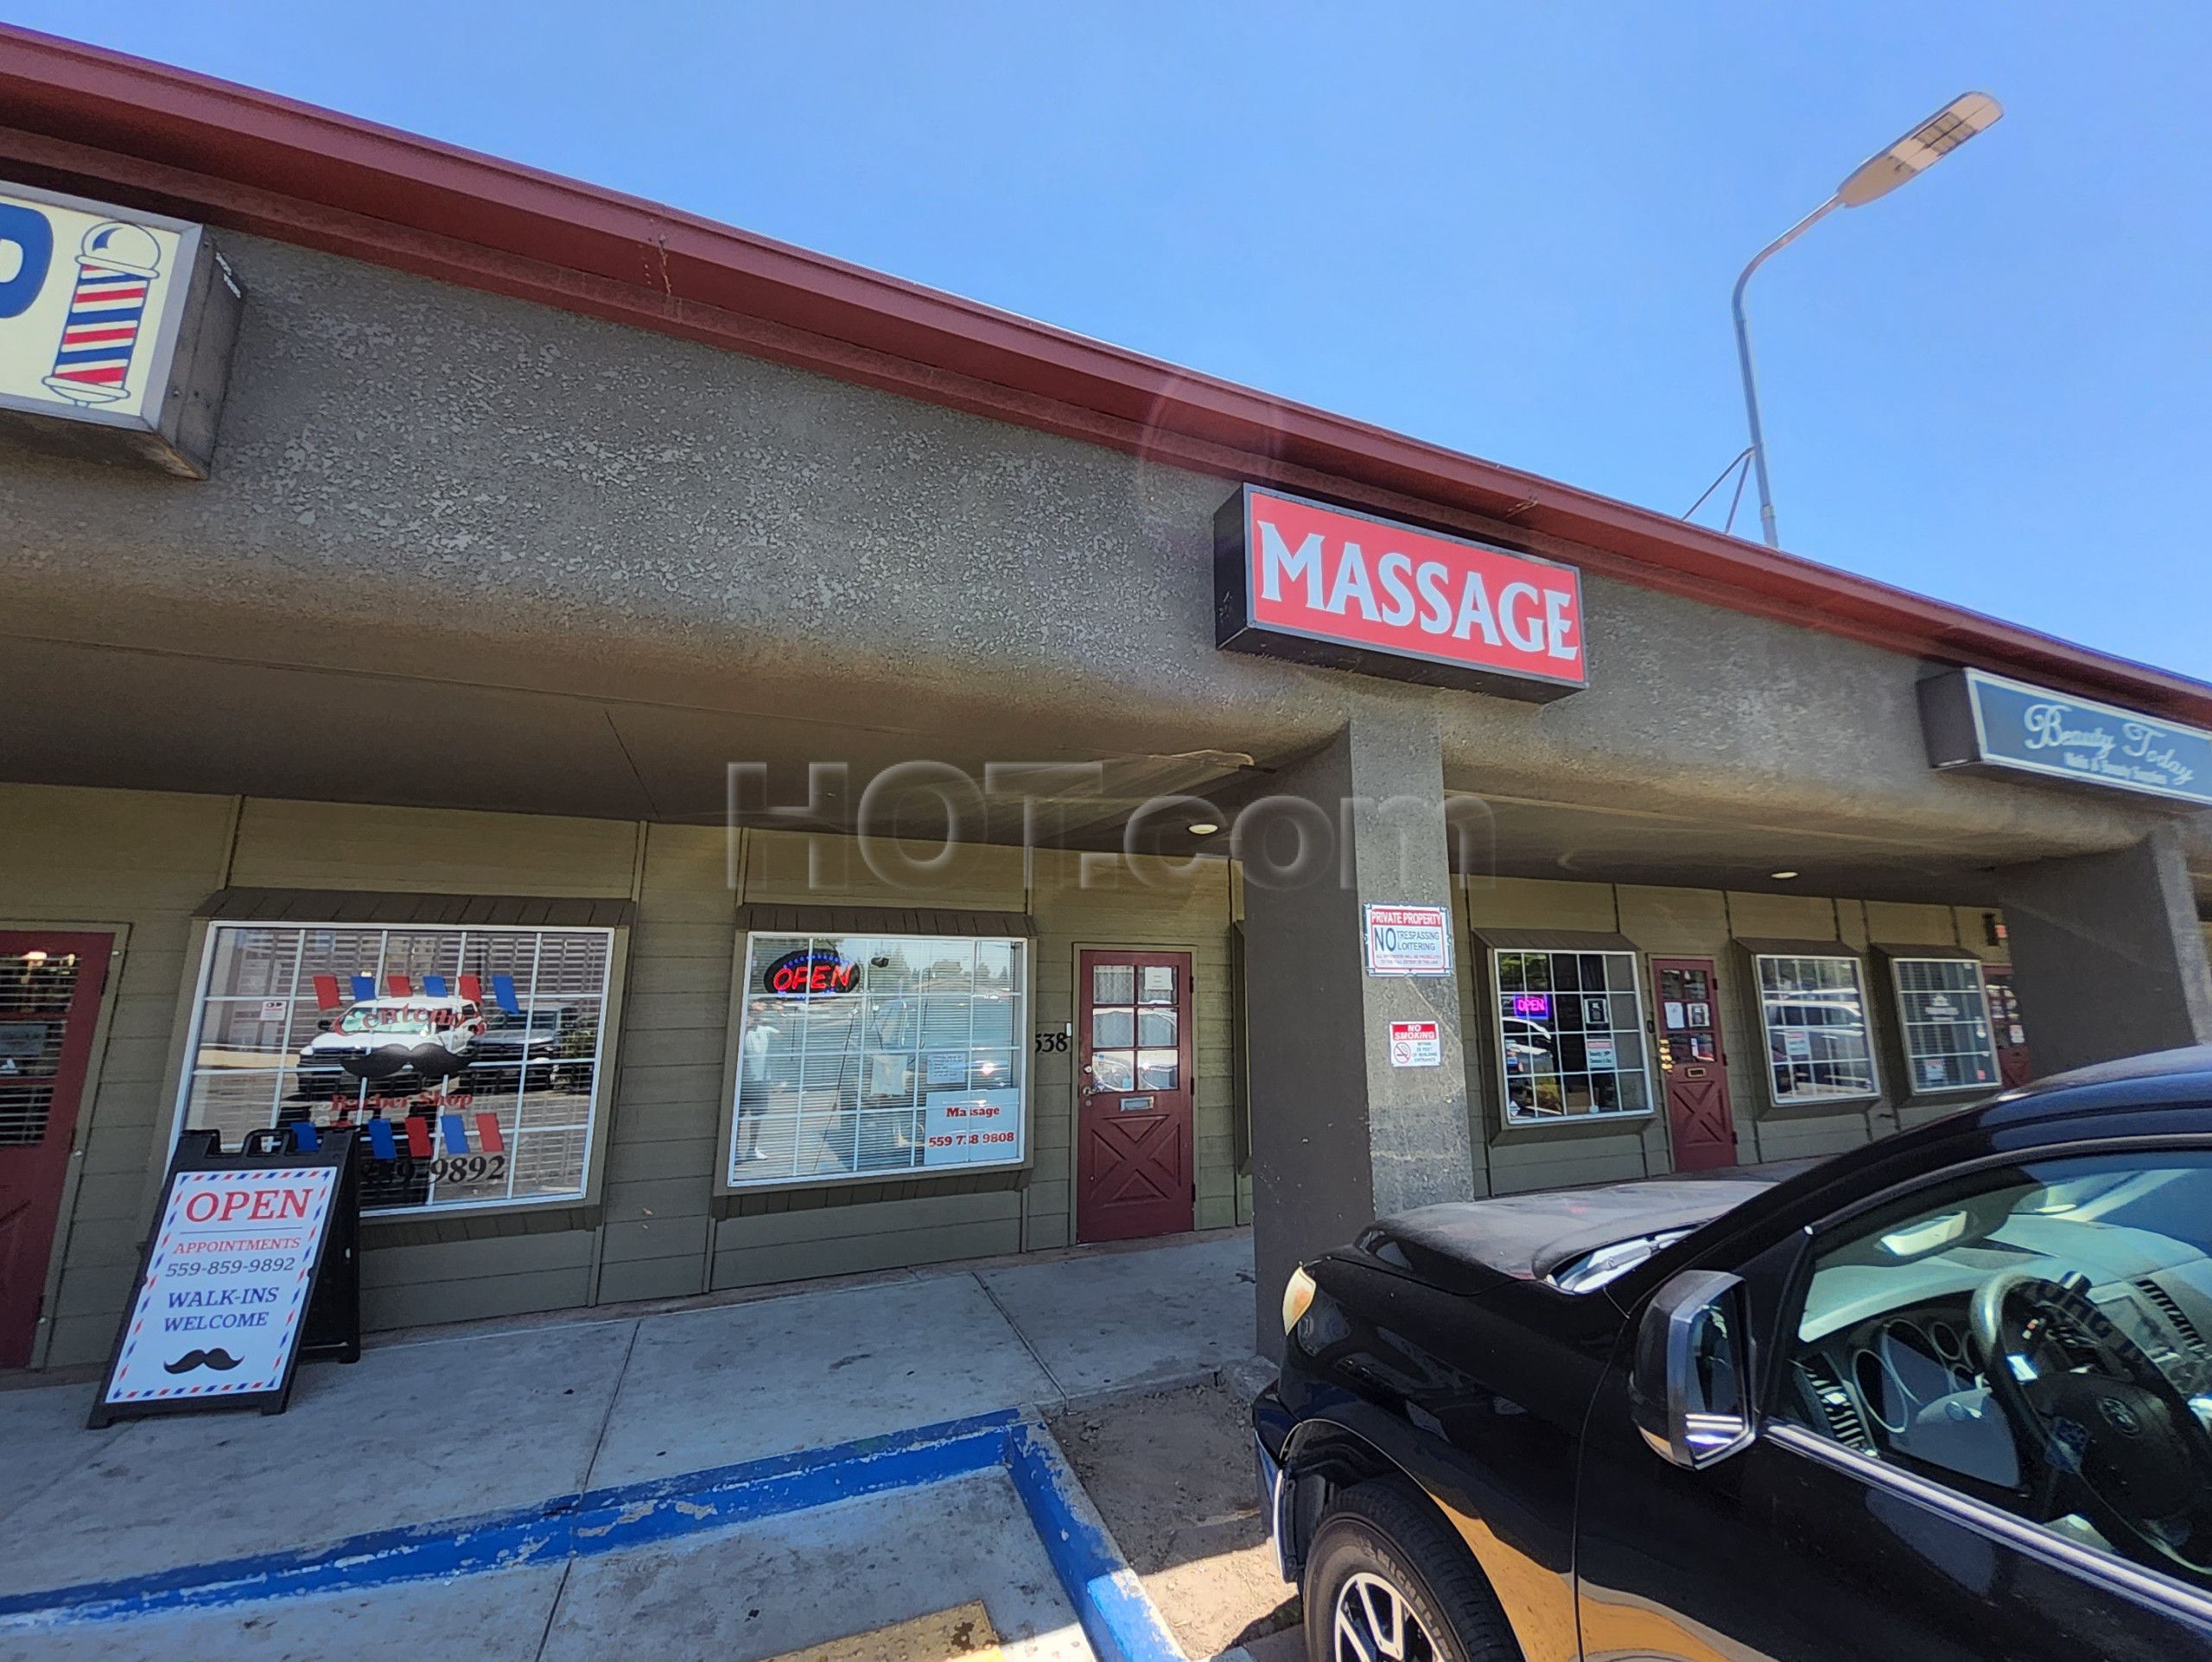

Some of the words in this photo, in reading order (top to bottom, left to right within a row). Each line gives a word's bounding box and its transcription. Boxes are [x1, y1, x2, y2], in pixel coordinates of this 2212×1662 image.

[1256, 519, 1579, 660] MASSAGE
[1371, 912, 1402, 924] PRIVATE
[1403, 913, 1441, 926] PROPERTY
[1374, 927, 1396, 952] NO
[1396, 931, 1440, 940] TRESPASSING
[773, 964, 854, 991] OPEN
[1518, 998, 1545, 1011] OPEN
[1394, 1031, 1435, 1040] SMOKING
[929, 1136, 952, 1147] 559
[982, 1132, 1014, 1143] 9808
[186, 1188, 313, 1223] OPEN
[173, 1238, 302, 1254] APPOINTMENTS
[165, 1257, 296, 1277] 559-859-9892
[168, 1286, 279, 1309] WALK-INS
[163, 1311, 270, 1333] WELCOME
